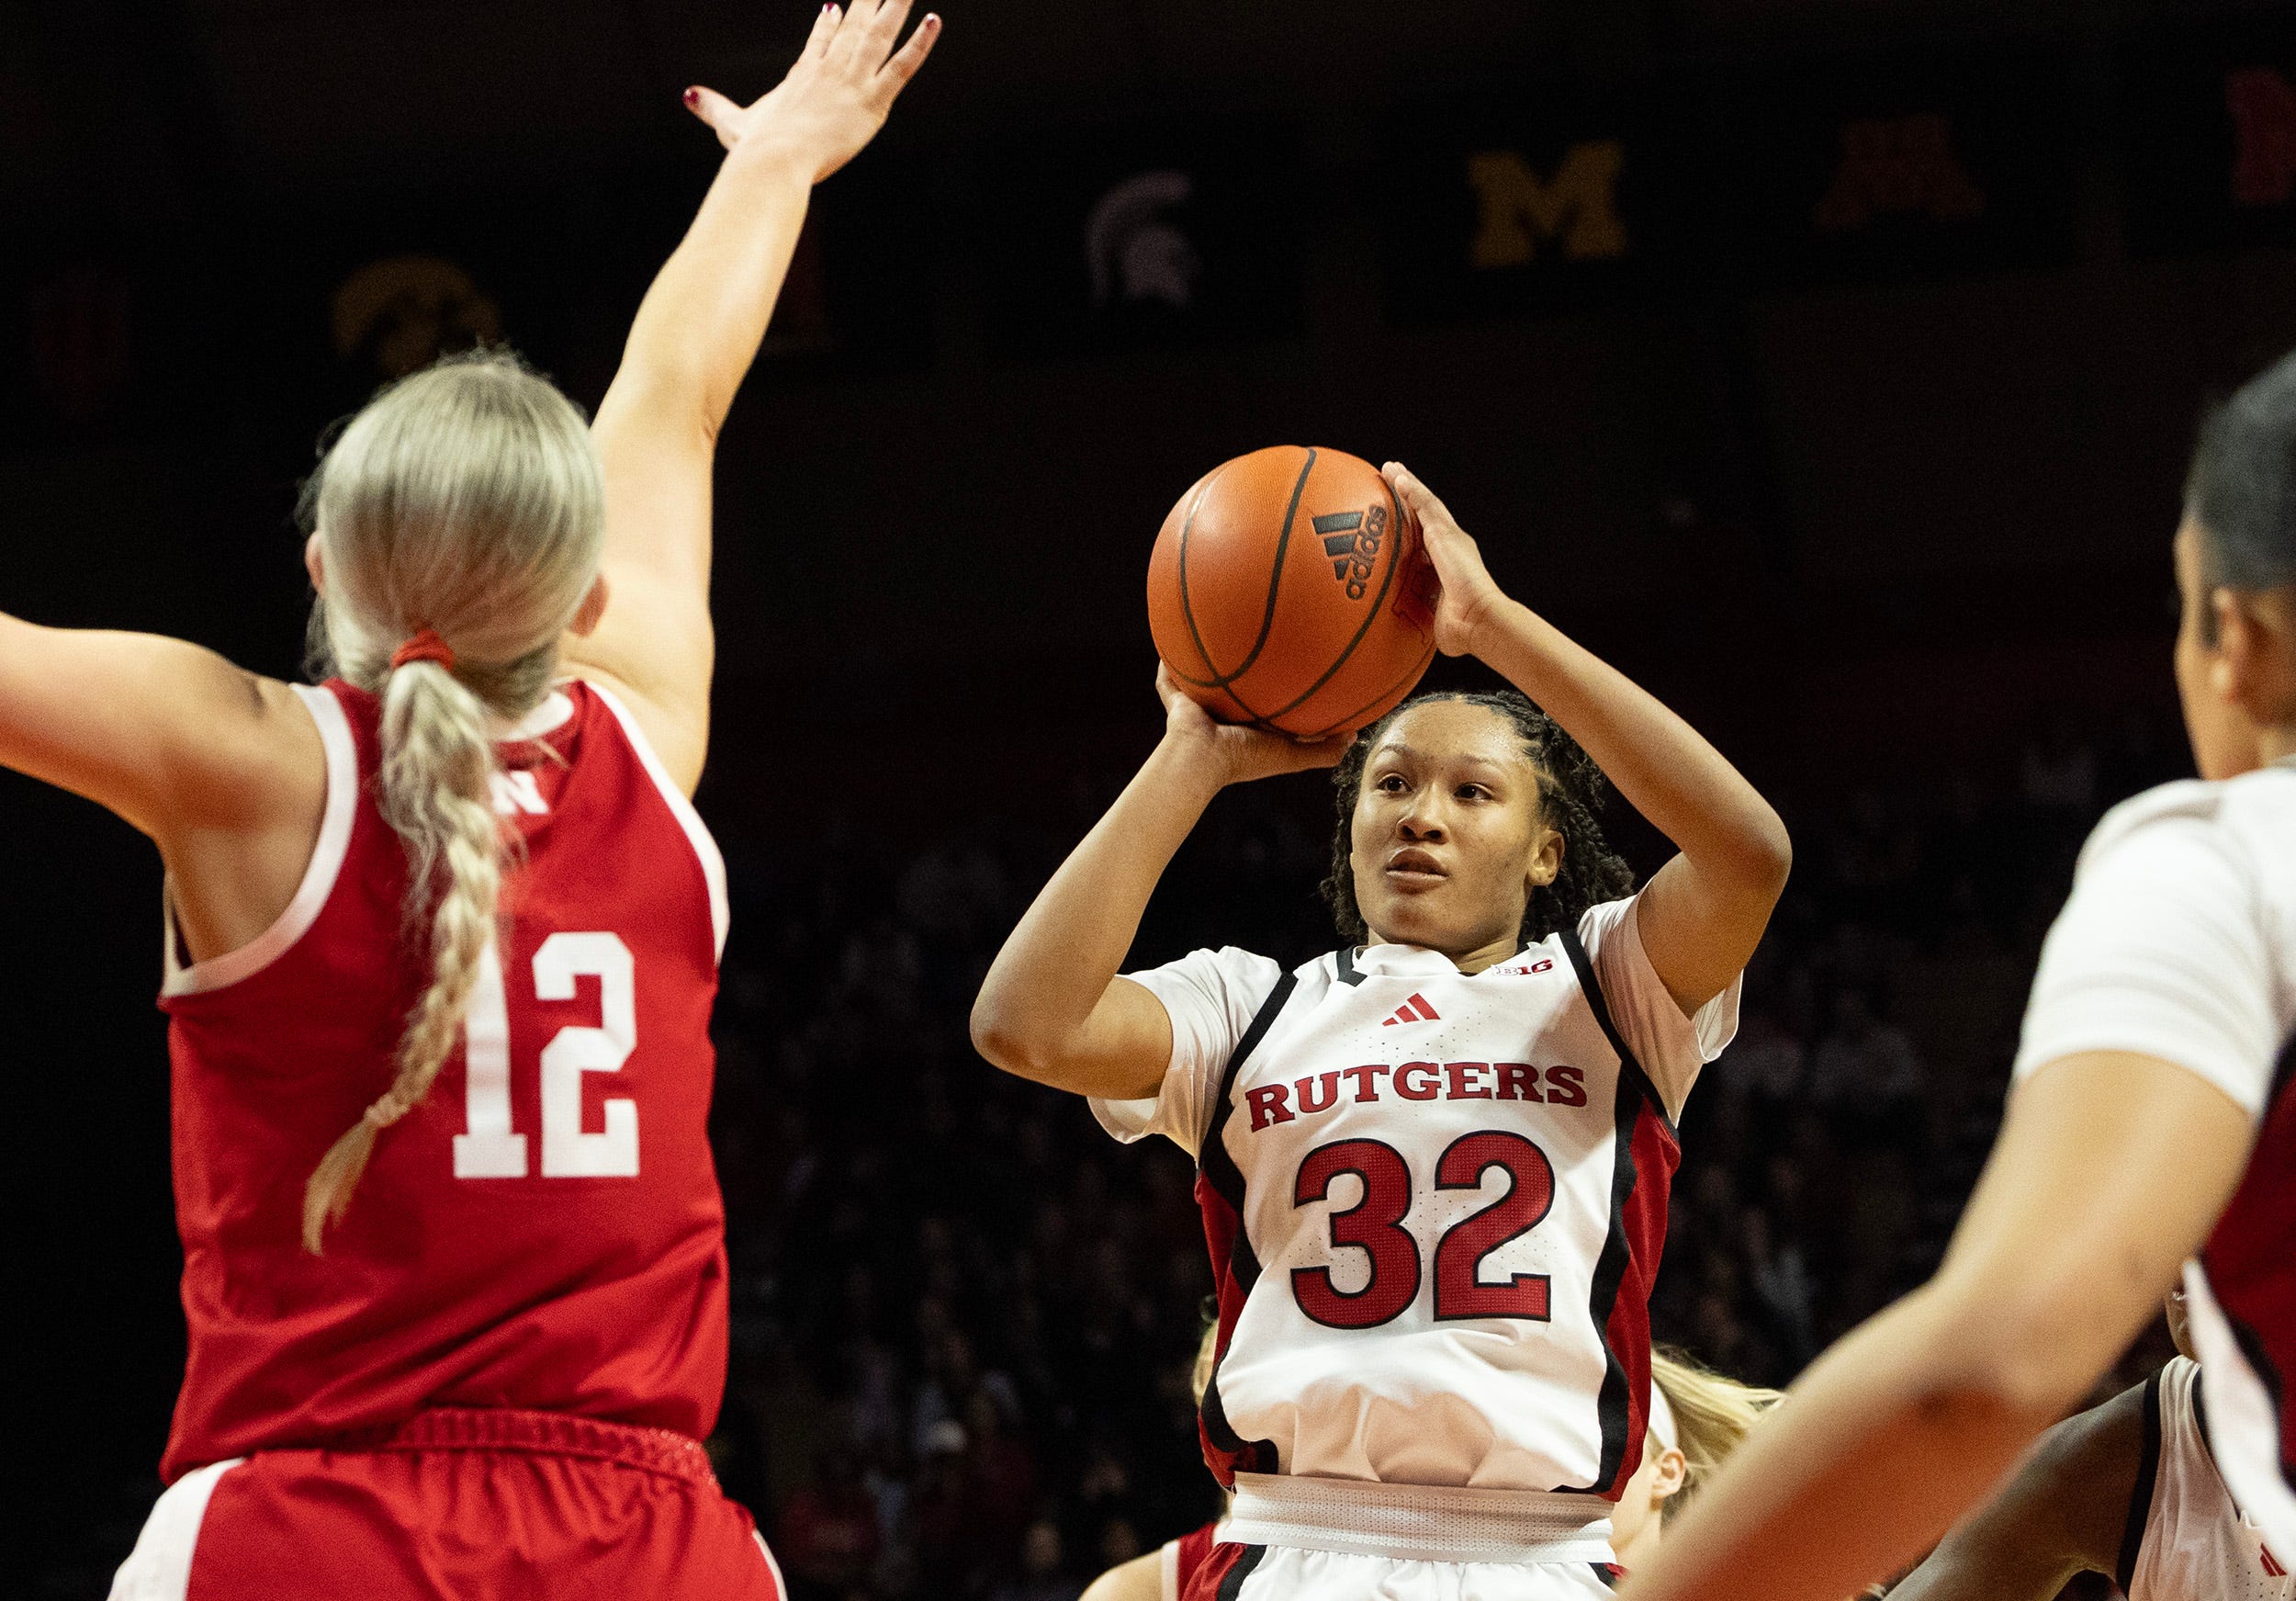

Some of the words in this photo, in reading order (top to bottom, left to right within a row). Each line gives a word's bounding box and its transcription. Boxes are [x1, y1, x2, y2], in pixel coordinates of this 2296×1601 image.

[1468, 141, 1627, 269] M
[1346, 505, 1386, 600] adidas
[453, 931, 639, 1178] 12
[1244, 1062, 1588, 1133] RUTGERS
[1289, 1130, 1556, 1330] 32
